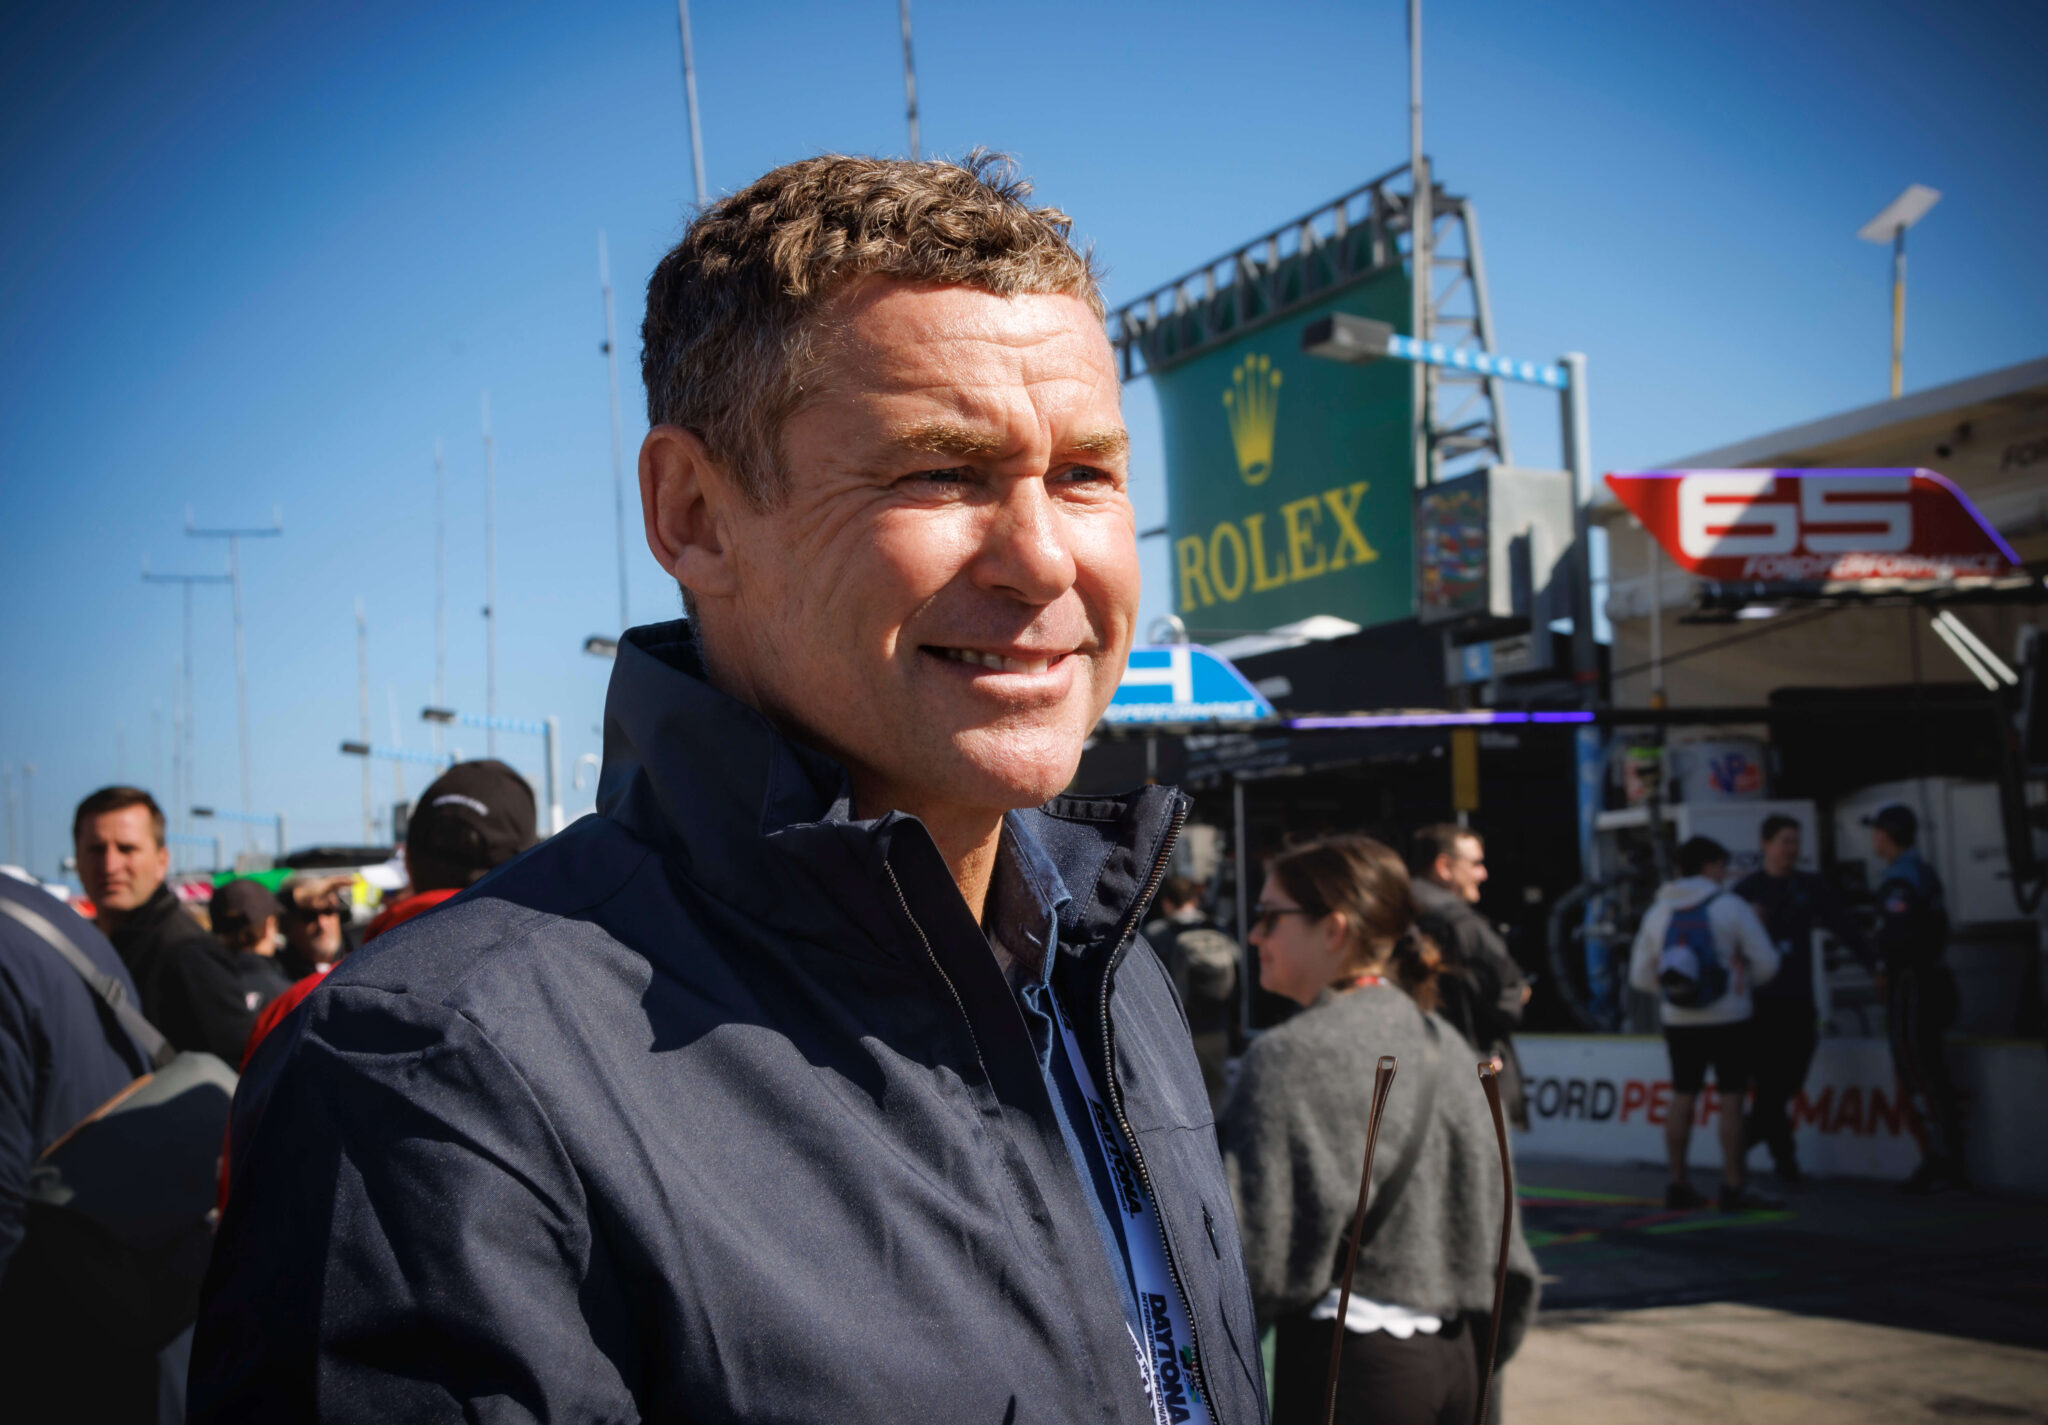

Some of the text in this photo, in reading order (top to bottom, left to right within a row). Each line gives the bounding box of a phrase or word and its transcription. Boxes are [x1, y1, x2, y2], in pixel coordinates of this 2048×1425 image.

[1177, 482, 1379, 612] ROLEX
[1678, 471, 1913, 558] 65
[1092, 1100, 1142, 1214] DAYTONA
[1522, 1077, 1618, 1121] FORD
[1141, 1292, 1159, 1369] INTERNATIONAL
[1153, 1374, 1169, 1425] SPEEDWAY
[1148, 1292, 1191, 1425] DAYTONA
